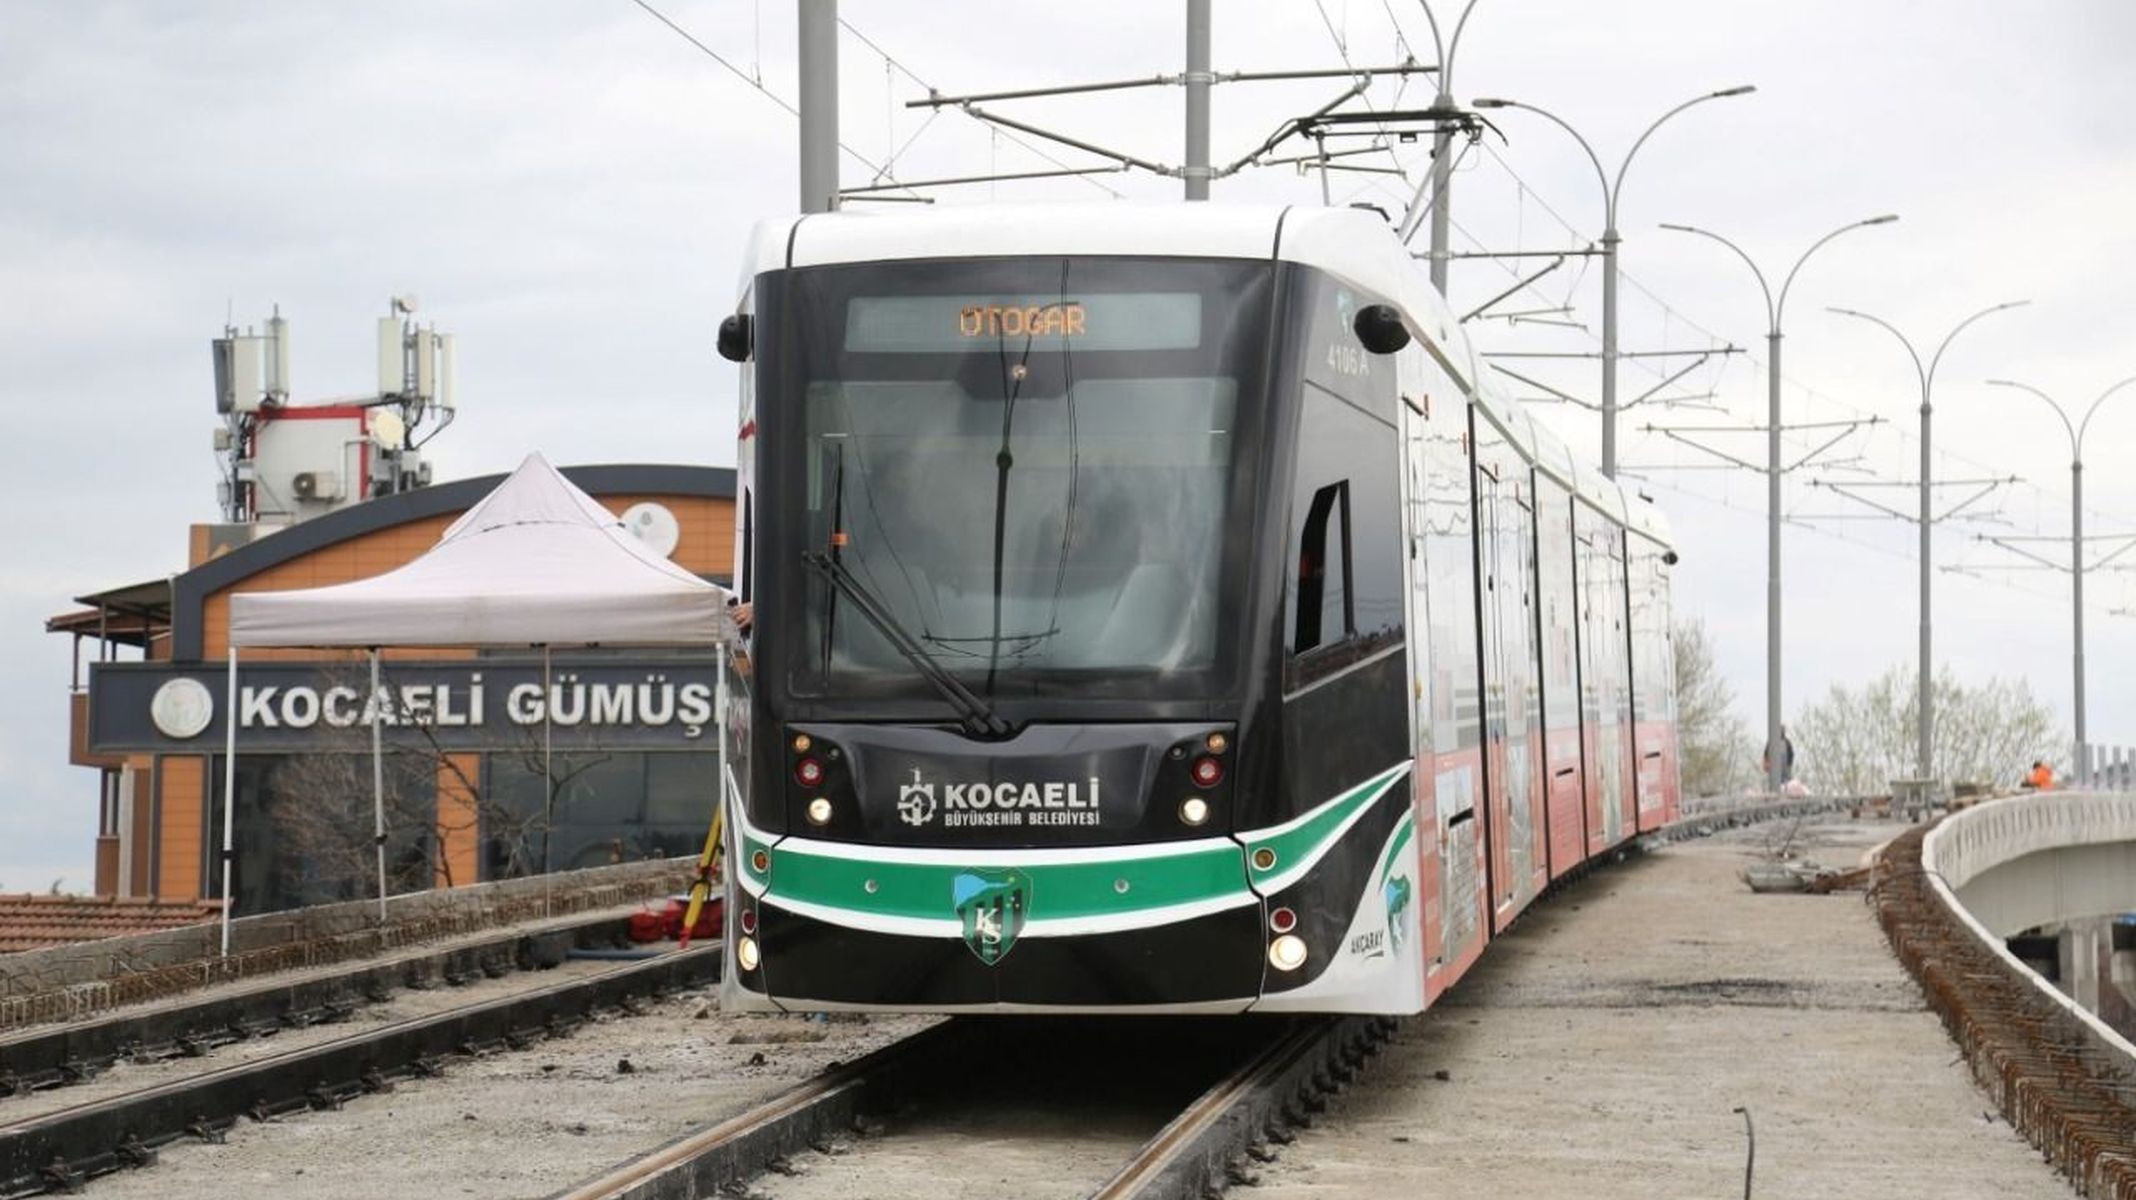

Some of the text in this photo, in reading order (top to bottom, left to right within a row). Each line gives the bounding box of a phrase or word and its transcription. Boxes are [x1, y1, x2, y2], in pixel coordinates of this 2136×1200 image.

[960, 303, 1087, 336] OTOGAR
[240, 673, 728, 738] KOCAELİ GÜMÜŞ
[944, 777, 1100, 809] KOCAELİ
[1028, 808, 1101, 827] BELEDİYESİ
